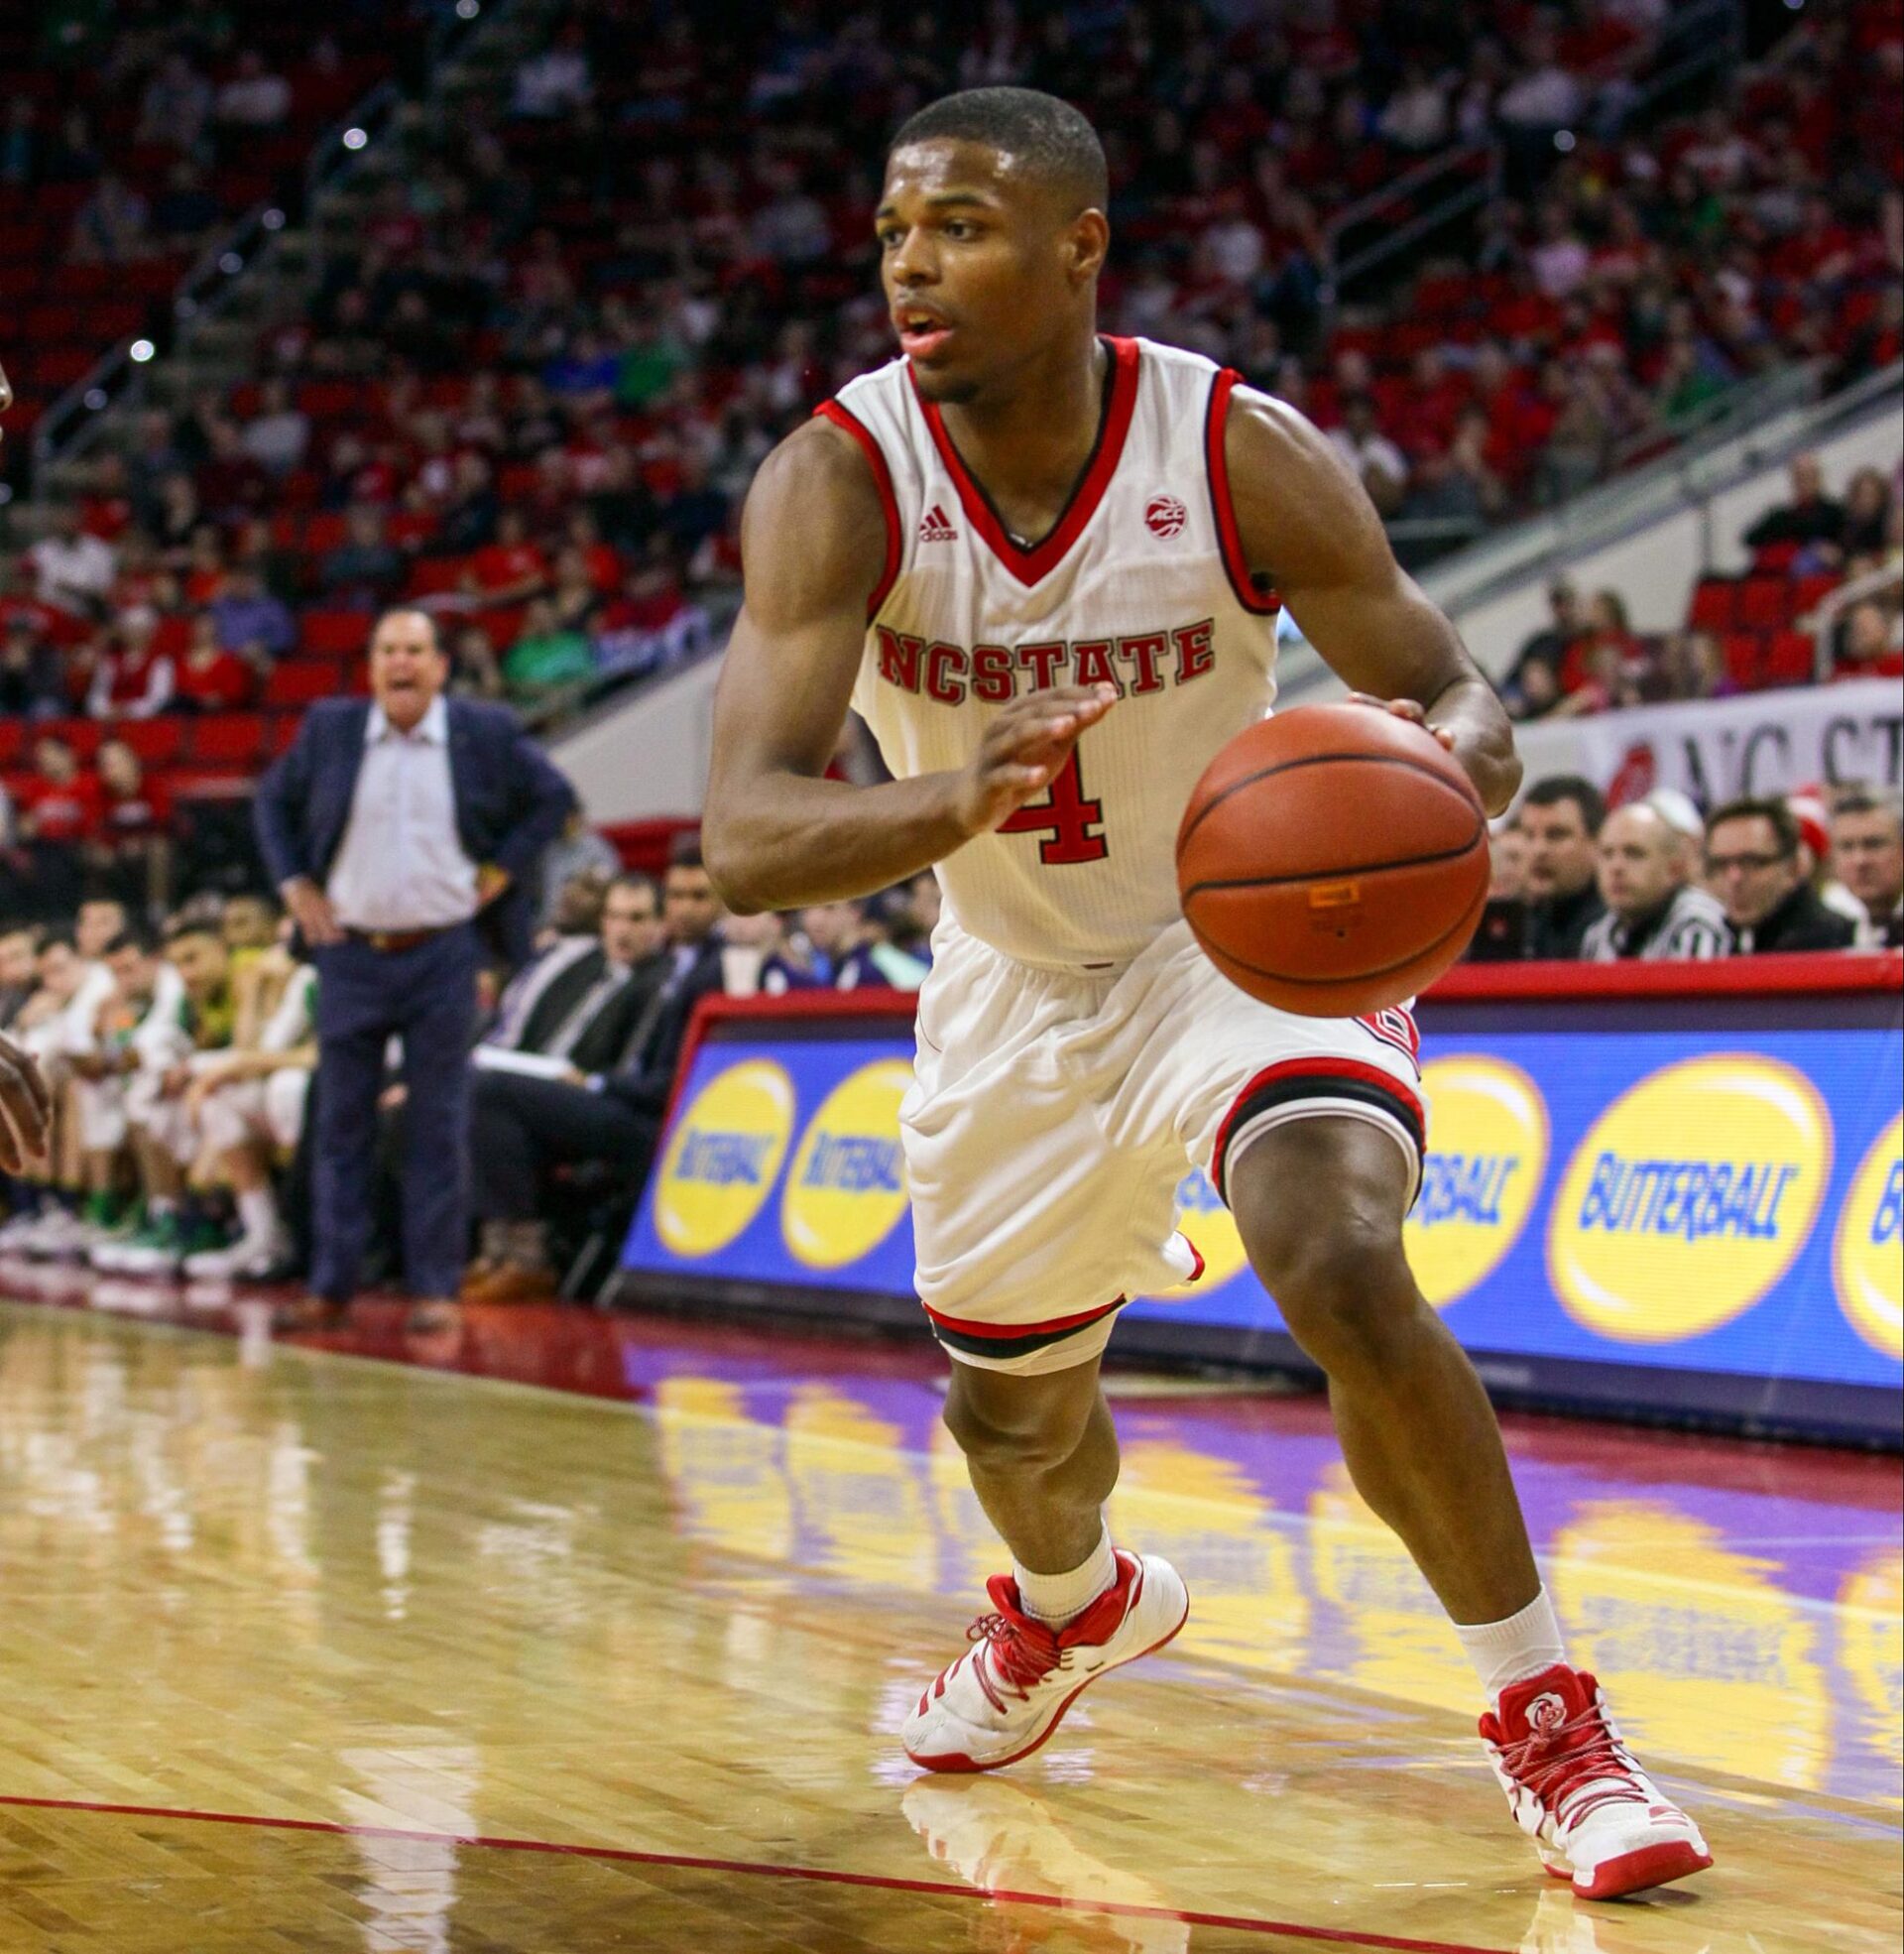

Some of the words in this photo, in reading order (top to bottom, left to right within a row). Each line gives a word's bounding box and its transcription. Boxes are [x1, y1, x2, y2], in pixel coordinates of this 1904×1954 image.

[920, 530, 959, 543] didas
[995, 742, 1109, 865] 4
[1407, 1154, 1518, 1226] RBALL
[1579, 1151, 1798, 1243] BUTTERBALL
